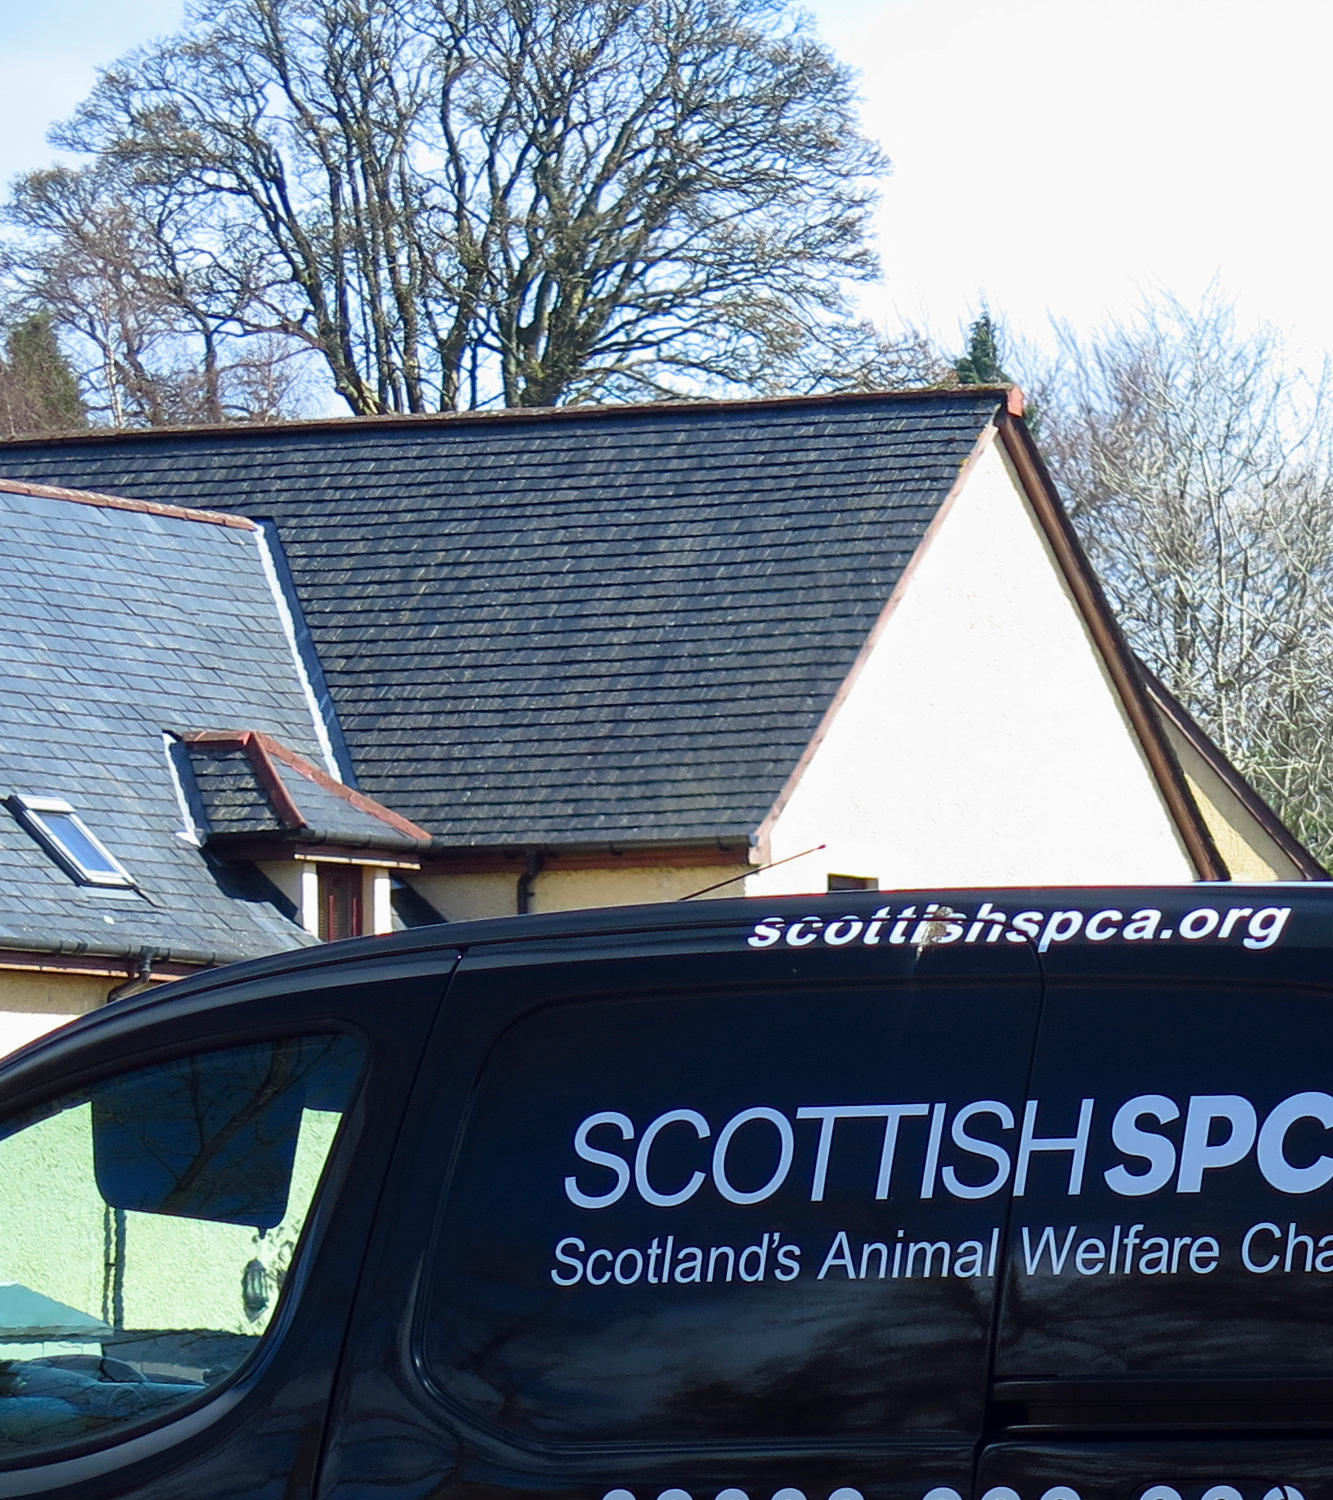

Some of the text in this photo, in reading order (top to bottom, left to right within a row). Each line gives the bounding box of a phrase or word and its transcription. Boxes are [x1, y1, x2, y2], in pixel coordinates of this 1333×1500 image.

[745, 901, 1292, 953] scottishspca.org
[550, 1232, 801, 1287] Scotland's
[816, 1227, 1000, 1280] Animal
[1021, 1224, 1221, 1277] Welfare
